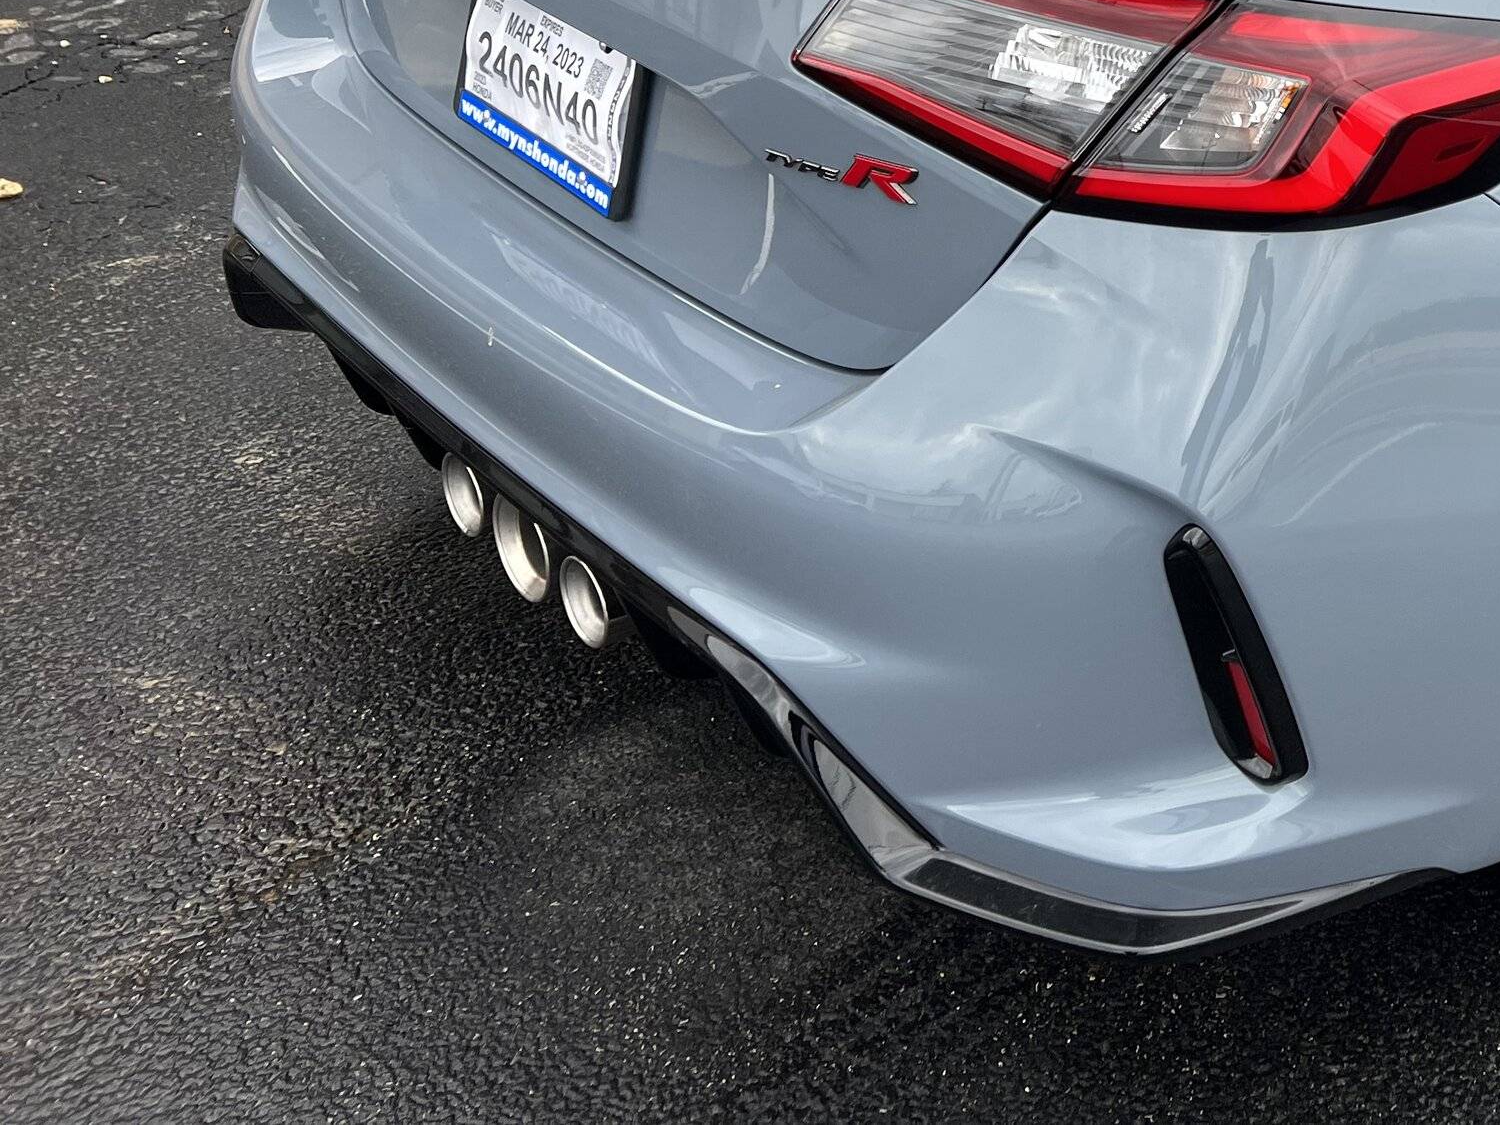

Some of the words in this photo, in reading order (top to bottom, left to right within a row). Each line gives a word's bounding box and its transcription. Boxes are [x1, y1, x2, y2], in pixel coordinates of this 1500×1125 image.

[505, 12, 535, 47] MAR
[533, 31, 551, 64] 24,
[552, 43, 585, 78] 2023
[540, 15, 564, 37] EXPIRES
[478, 31, 599, 145] 2406N40
[764, 147, 841, 181] TYPE
[840, 152, 920, 206] R
